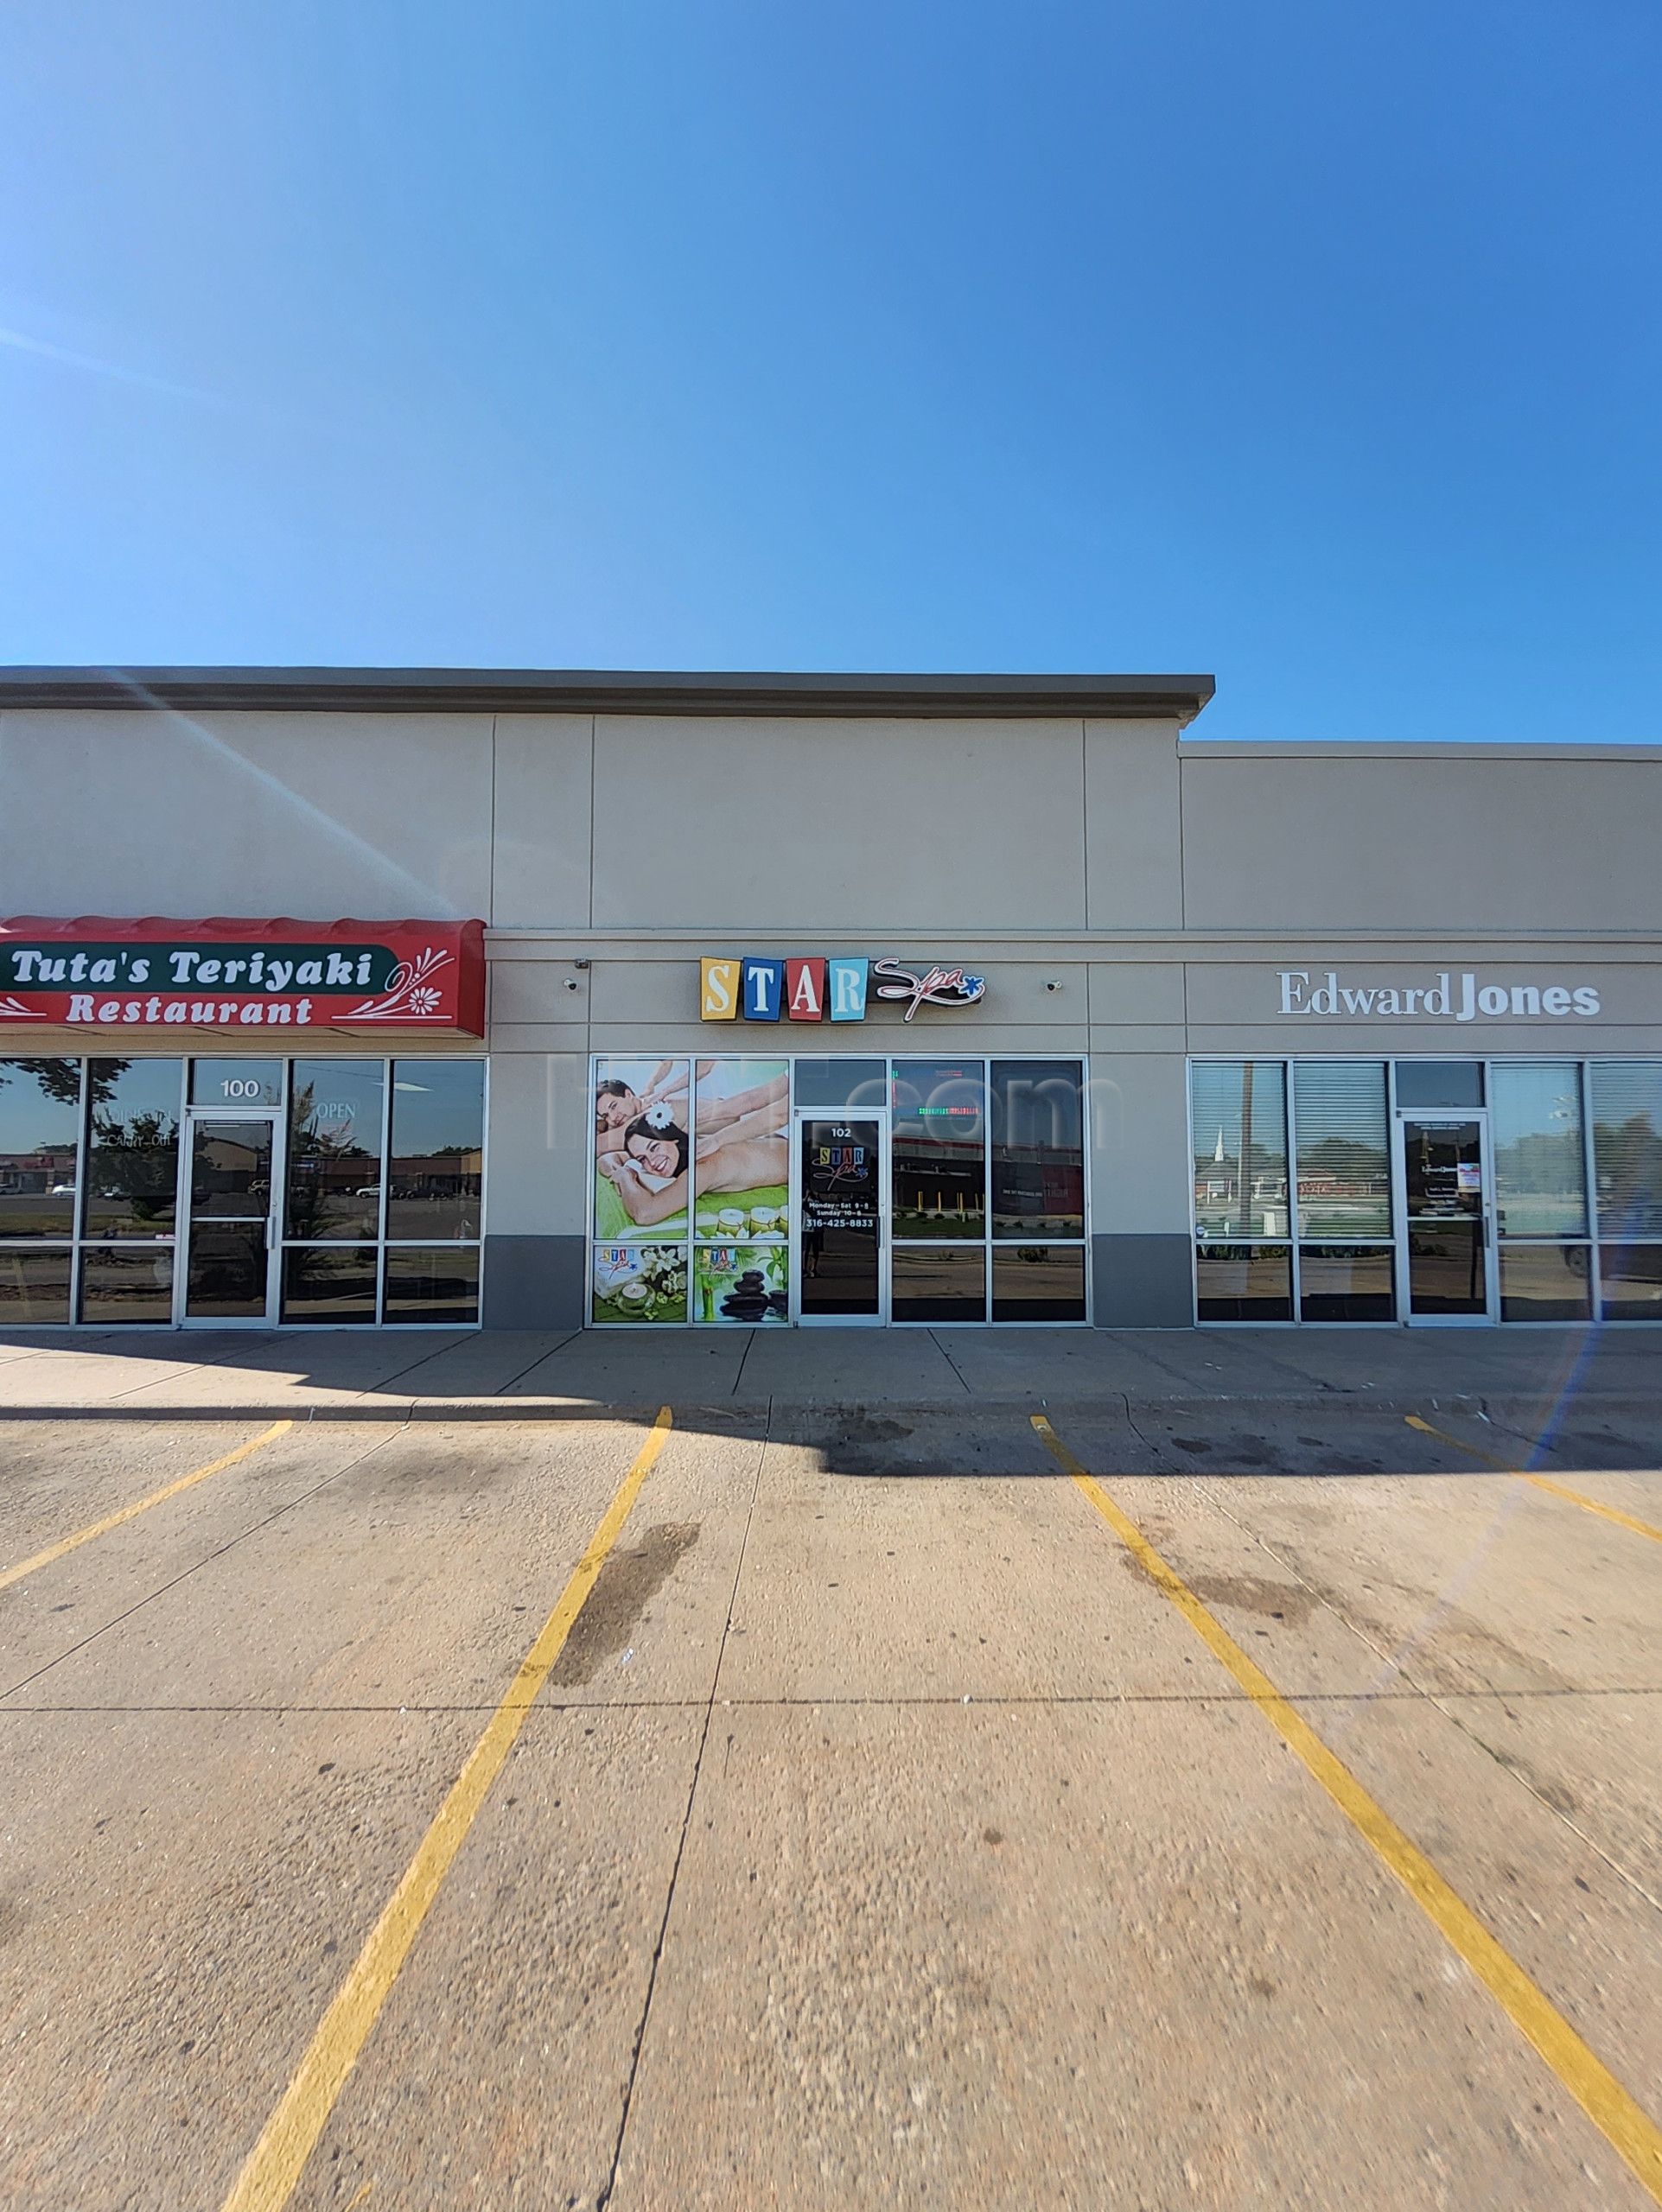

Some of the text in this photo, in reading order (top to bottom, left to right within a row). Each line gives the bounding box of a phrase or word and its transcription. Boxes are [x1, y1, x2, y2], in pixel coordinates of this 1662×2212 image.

[11, 951, 372, 991] Tuta's Teriyaki
[705, 957, 985, 1022] STAR Spa
[1276, 972, 1601, 1020] Edward Jones
[66, 995, 313, 1024] Restaurant
[220, 1080, 259, 1097] 100
[316, 1103, 356, 1119] OPEN
[831, 1128, 851, 1137] 102
[820, 1147, 863, 1164] STAR
[806, 1218, 873, 1227] 316-425-8833
